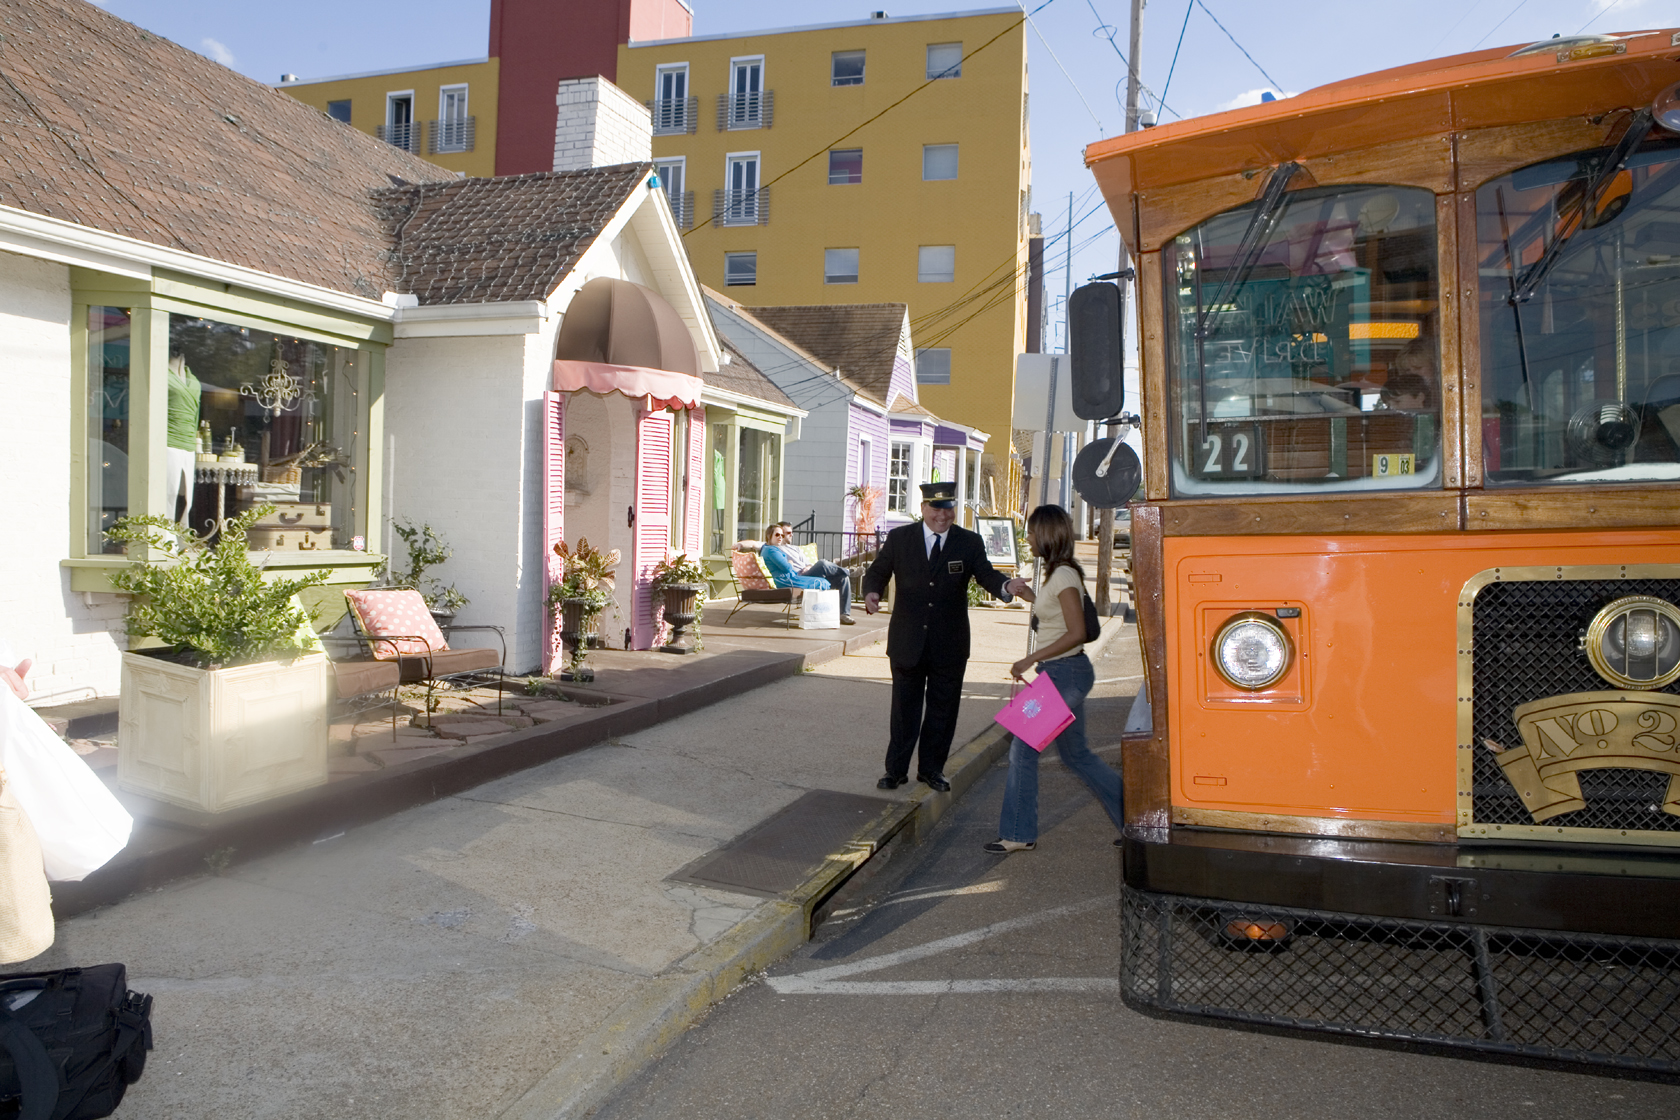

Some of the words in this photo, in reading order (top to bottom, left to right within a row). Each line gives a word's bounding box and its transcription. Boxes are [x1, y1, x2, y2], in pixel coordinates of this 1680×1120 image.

[1202, 433, 1249, 473] 22
[1380, 456, 1389, 474] 9
[1400, 459, 1410, 475] 03
